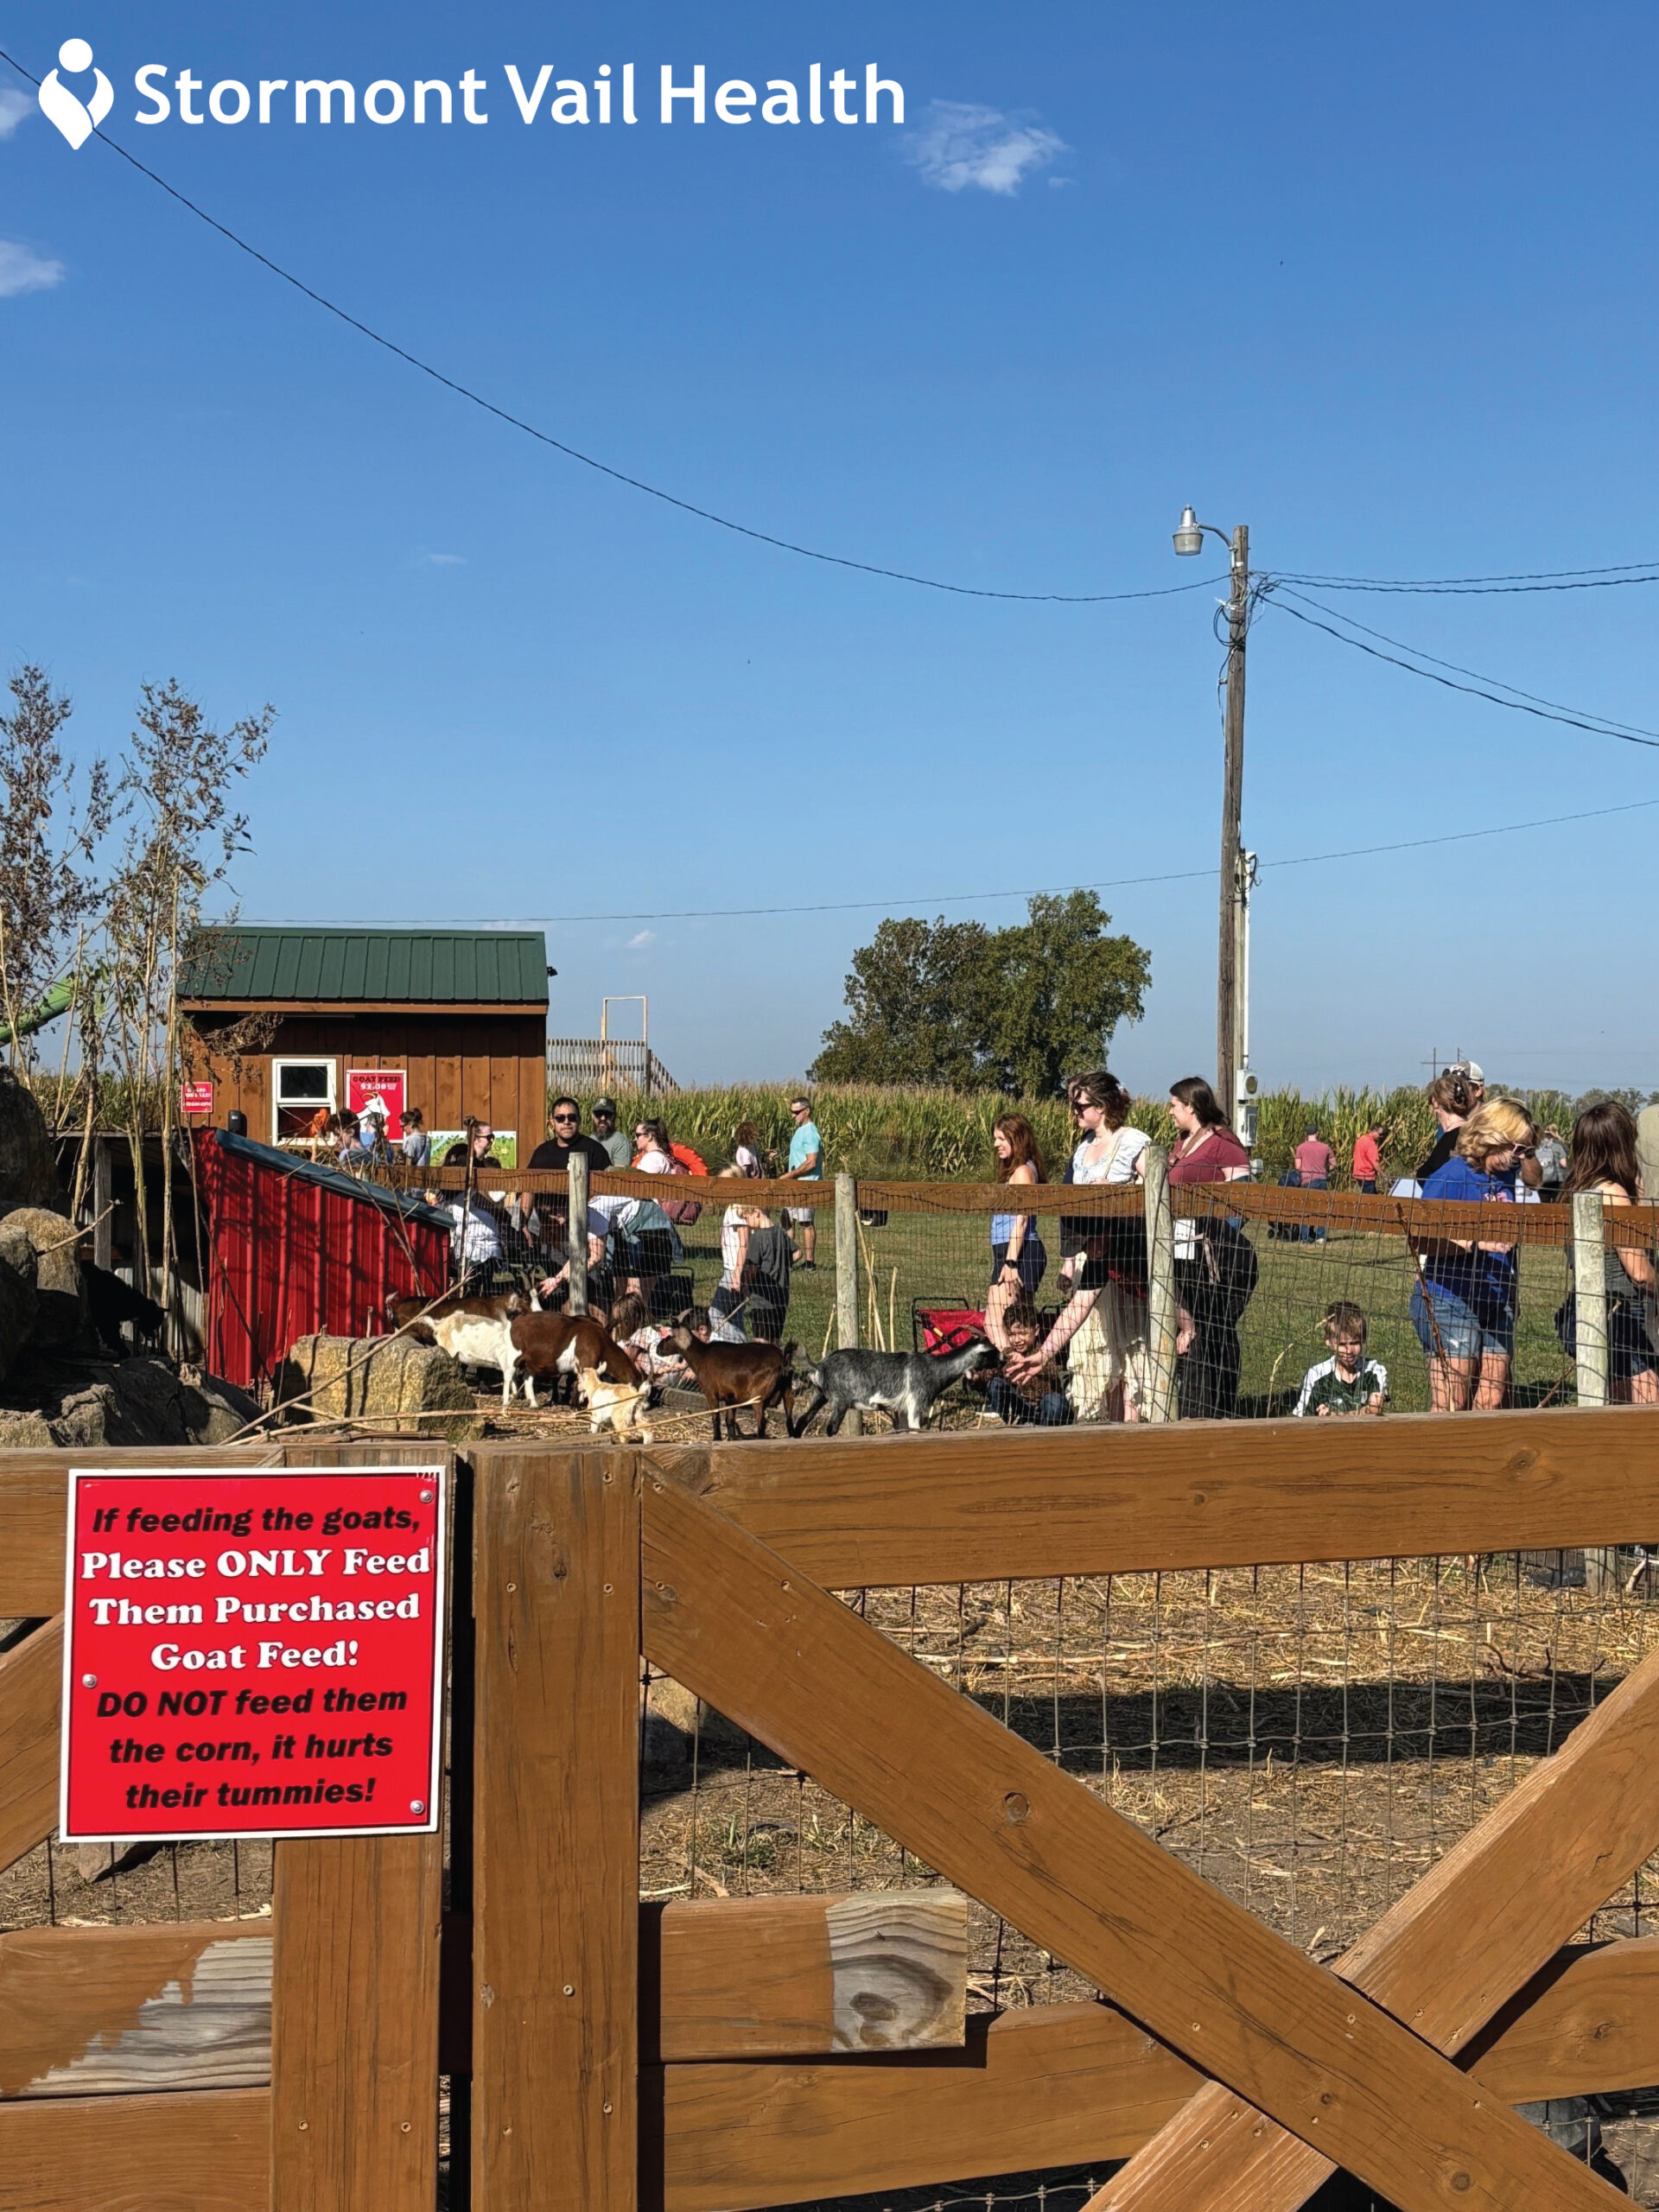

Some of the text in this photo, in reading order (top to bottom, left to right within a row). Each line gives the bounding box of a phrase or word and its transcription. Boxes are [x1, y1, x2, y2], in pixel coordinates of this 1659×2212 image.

[93, 1507, 420, 1537] If feeding the goats,
[82, 1548, 430, 1579] Please ONLY Feed
[89, 1593, 420, 1624] Them Purchased
[150, 1640, 359, 1670] Goat Feed!
[97, 1688, 407, 1717] DO NOT feed them
[110, 1733, 393, 1765] the corn, it hurts
[126, 1778, 375, 1808] their tummies!
